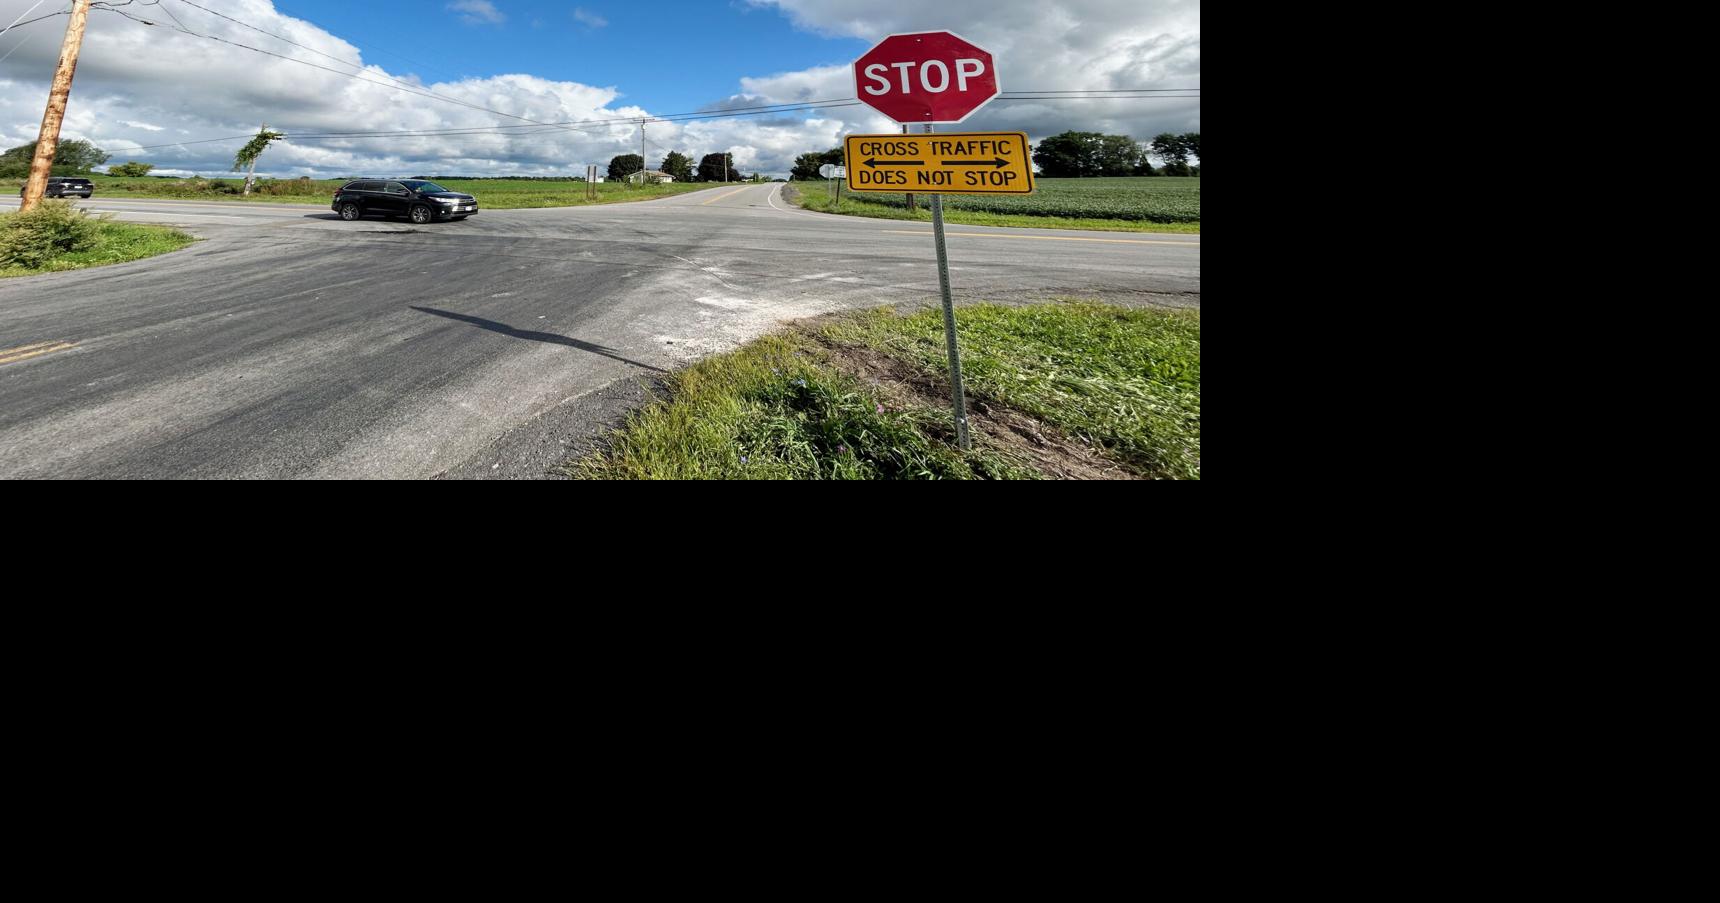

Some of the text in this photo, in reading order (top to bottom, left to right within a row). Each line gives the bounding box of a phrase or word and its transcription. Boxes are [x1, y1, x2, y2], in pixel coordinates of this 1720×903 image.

[864, 58, 985, 96] STOP
[860, 140, 1011, 156] CROSS TRAFFIC
[859, 170, 907, 184] DOES
[917, 170, 954, 185] NOT
[965, 170, 1017, 186] STOP
